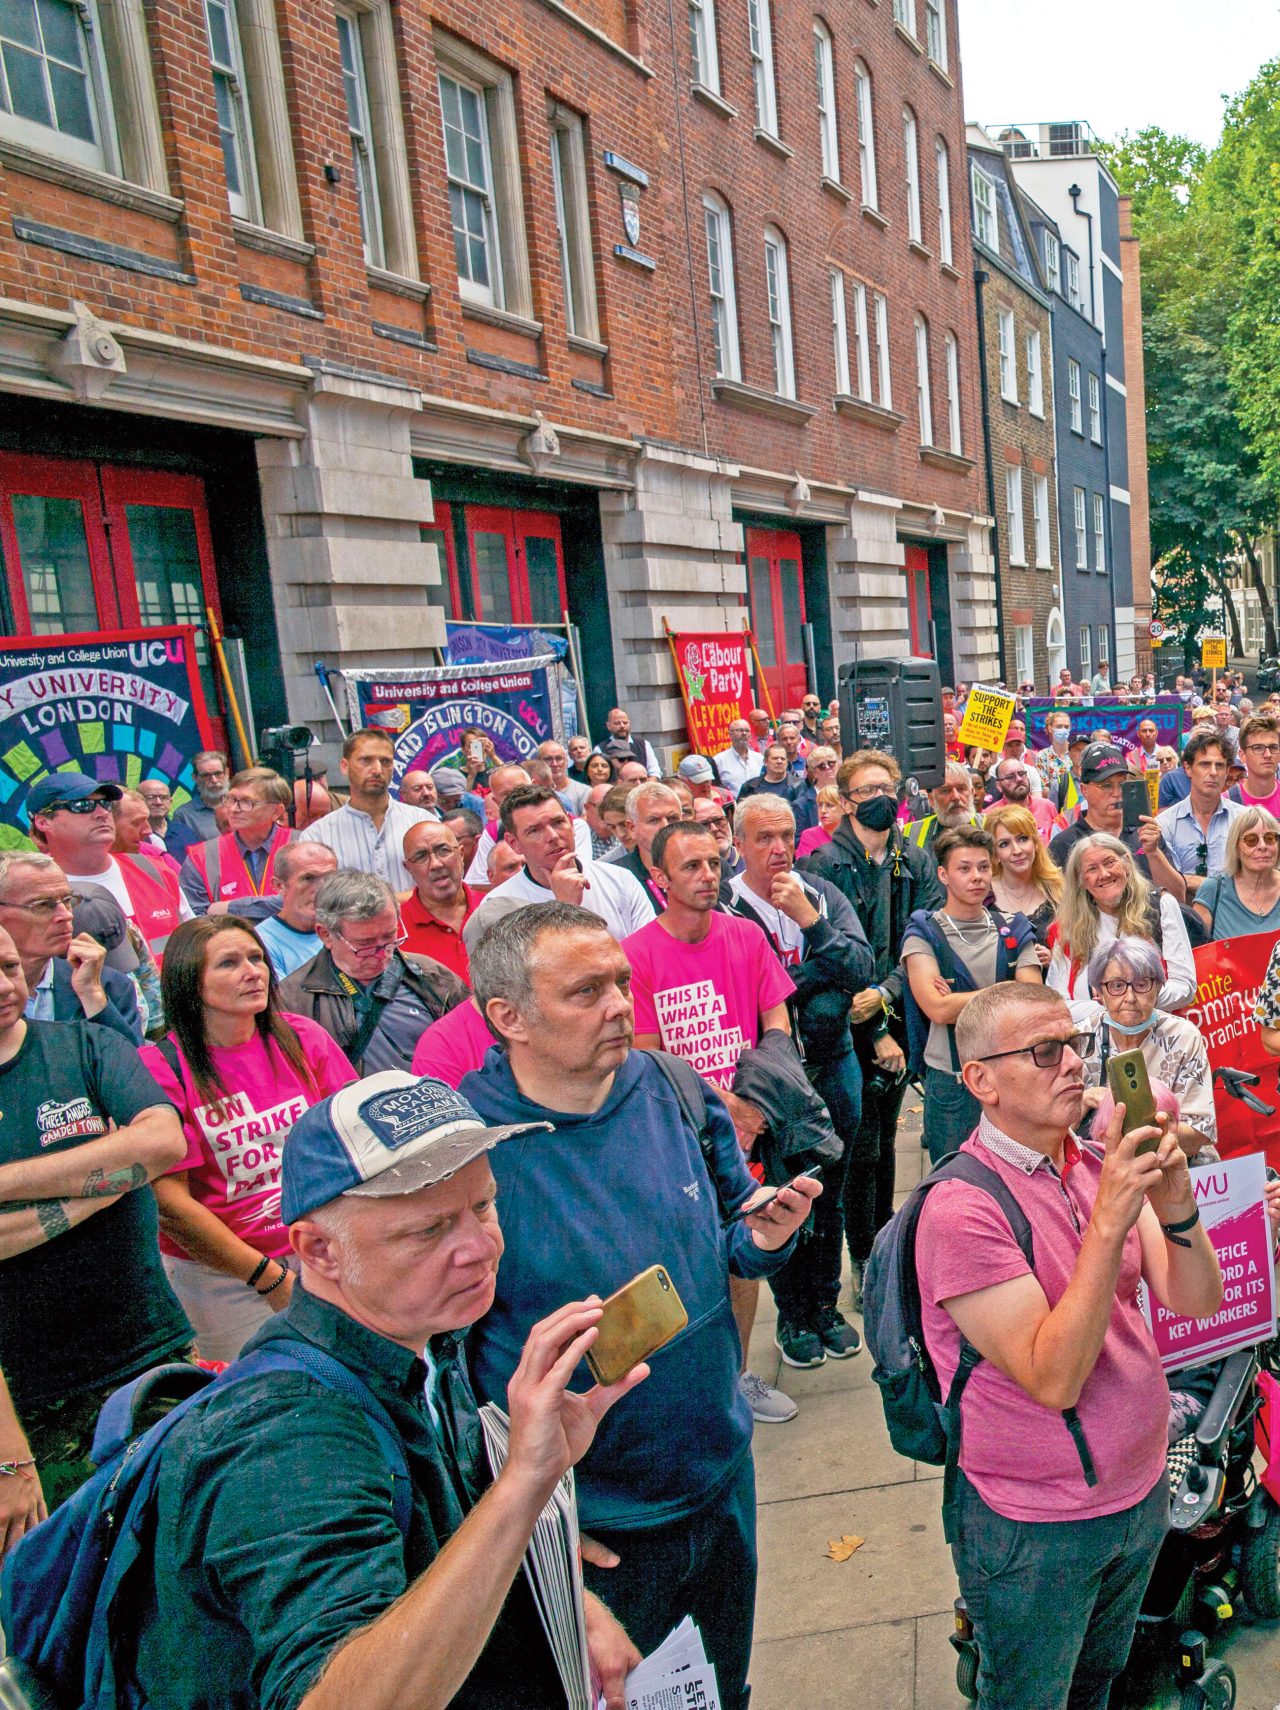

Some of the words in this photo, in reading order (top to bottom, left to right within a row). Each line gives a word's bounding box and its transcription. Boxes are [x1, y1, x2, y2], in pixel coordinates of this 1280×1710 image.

[1151, 625, 1162, 633] 20
[0, 655, 46, 670] University
[47, 651, 66, 664] and
[67, 649, 101, 663] College
[102, 647, 128, 659] Union
[702, 642, 742, 667] Labour
[28, 672, 178, 713] UNIVERSITY
[375, 684, 436, 698] University
[439, 682, 458, 694] and
[461, 680, 499, 692] College
[500, 676, 531, 688] Union
[710, 668, 743, 699] Party
[973, 692, 1011, 710] SUPPORT
[982, 705, 997, 716] THE
[20, 700, 133, 735] LONDON
[423, 704, 508, 738] ISLINGTON
[694, 702, 740, 728] LEYTON
[970, 712, 1003, 729] STRIKES
[1034, 715, 1130, 733] HKNEY
[658, 988, 692, 1009] THIS
[697, 984, 710, 999] IS
[1185, 986, 1262, 1030] ommu
[661, 1002, 708, 1026] WHAT
[712, 1000, 722, 1013] A
[665, 1018, 716, 1042] TRADE
[670, 1031, 740, 1056] UNIONIST
[41, 1110, 66, 1130] THREE
[205, 1099, 246, 1128] ON
[409, 1099, 452, 1116] TEAM
[42, 1123, 78, 1144] CAMDEN
[79, 1118, 105, 1133] TOWN
[215, 1102, 302, 1152] STRIKE
[226, 1142, 279, 1177] FOR
[233, 1165, 282, 1196] PAY
[1193, 1172, 1229, 1200] WU
[1216, 1241, 1249, 1263] FFICE
[1221, 1265, 1245, 1283] ORD
[1247, 1260, 1258, 1275] A
[1222, 1285, 1243, 1303] OR
[1246, 1277, 1265, 1296] ITS
[1157, 1305, 1184, 1323] PA
[1168, 1321, 1194, 1341] KEY
[1196, 1300, 1259, 1333] WORKERS
